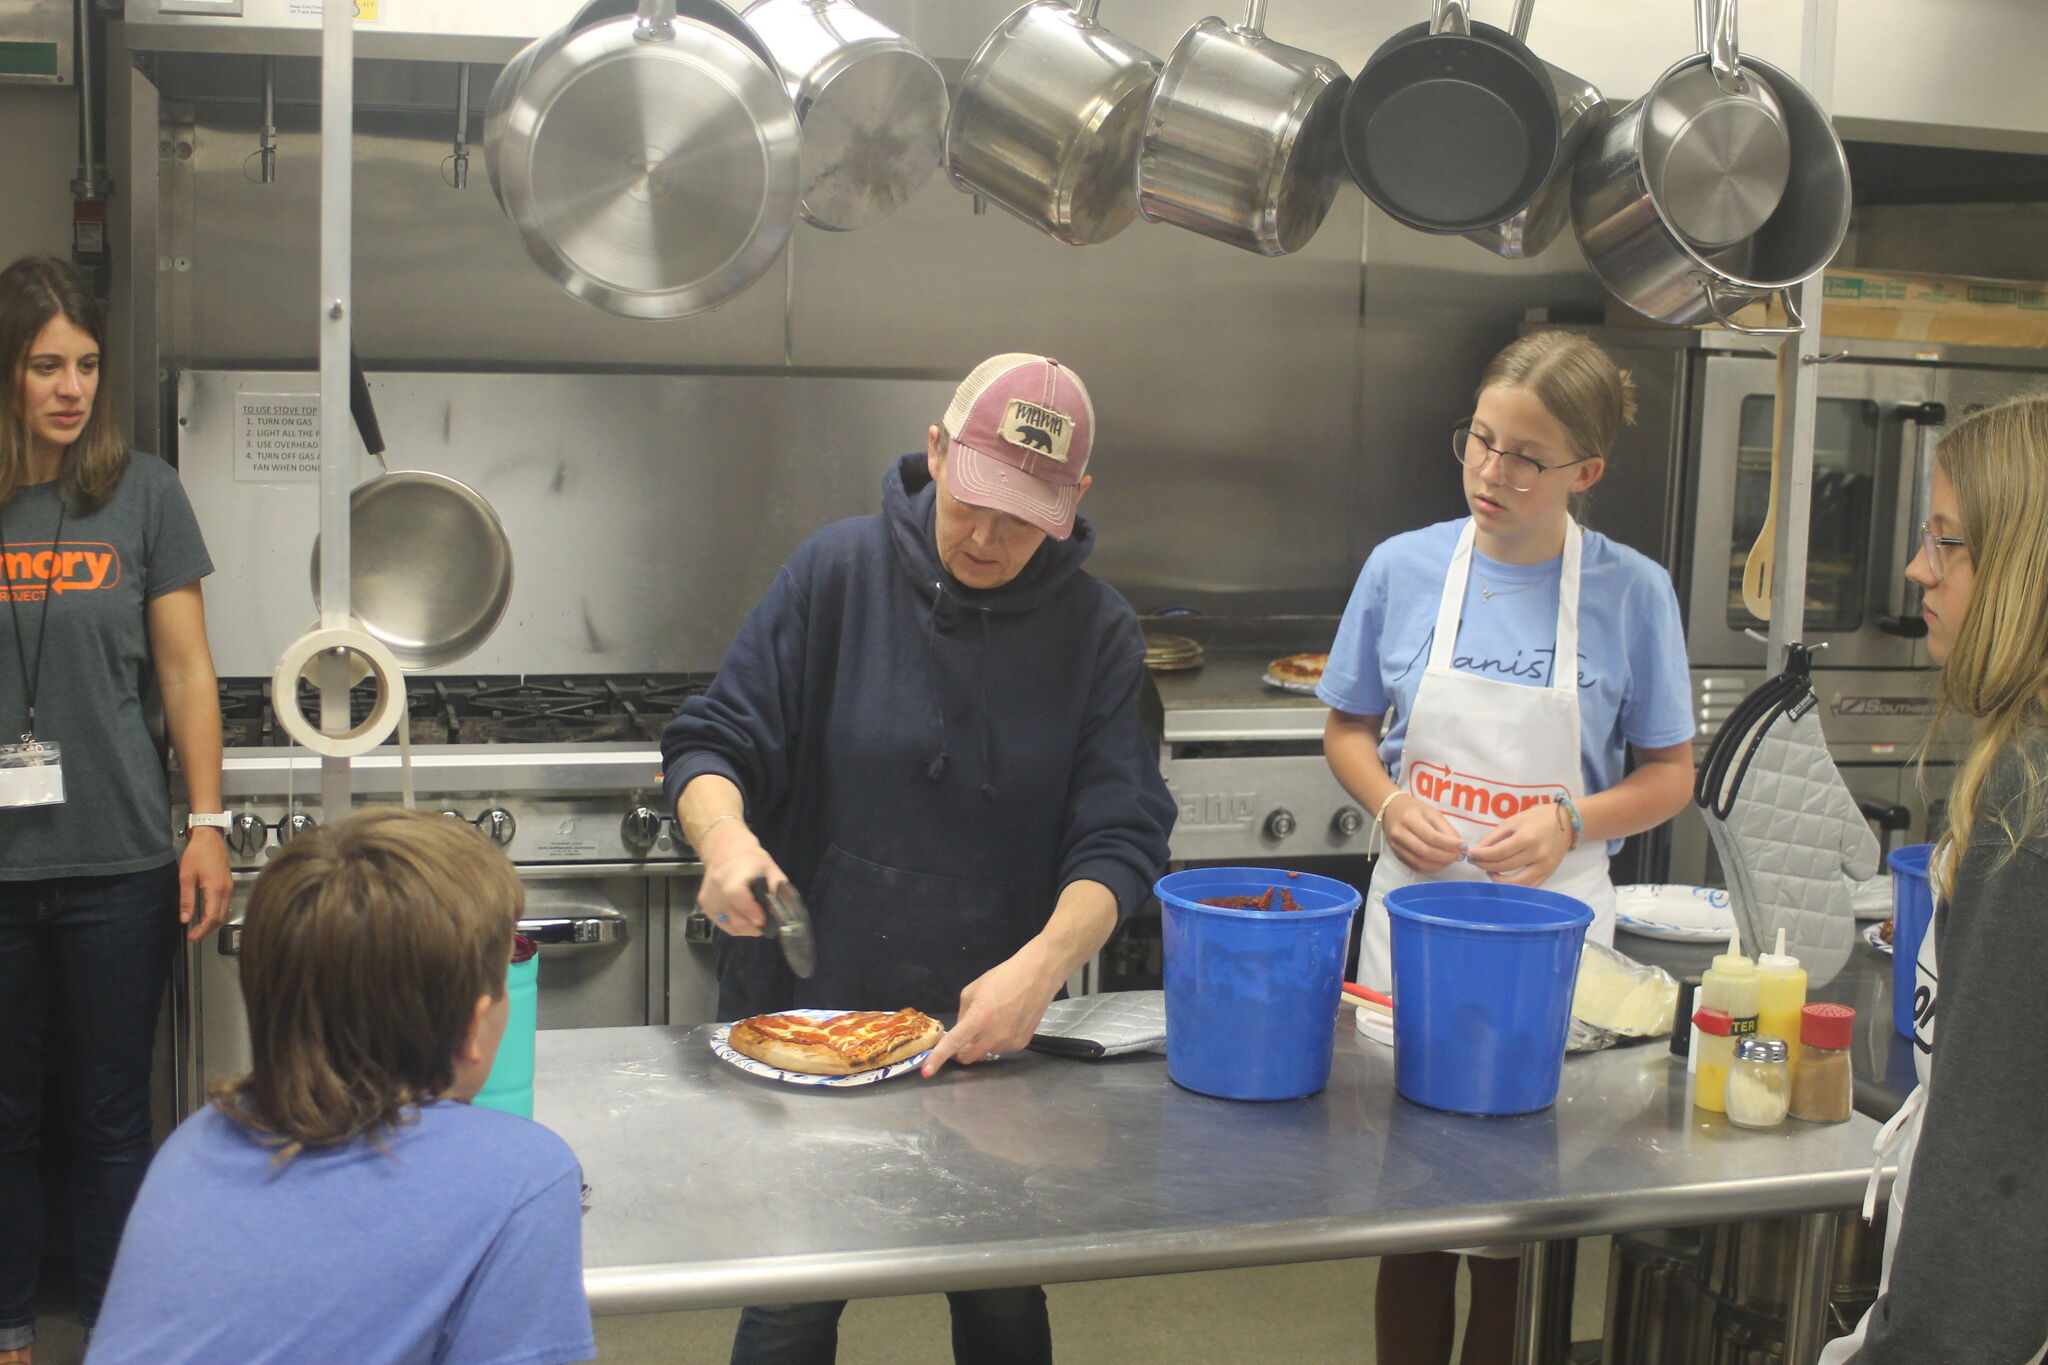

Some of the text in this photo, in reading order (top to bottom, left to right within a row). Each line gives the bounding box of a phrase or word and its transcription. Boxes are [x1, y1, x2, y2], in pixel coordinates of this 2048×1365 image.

[243, 406, 318, 415] TO USE STOVE TOP
[281, 418, 294, 426] ON
[296, 418, 313, 426] GAS
[1015, 403, 1063, 436] MAMA
[274, 441, 319, 449] OVERHEAD
[257, 452, 279, 460] TURN
[1416, 771, 1551, 819] armor
